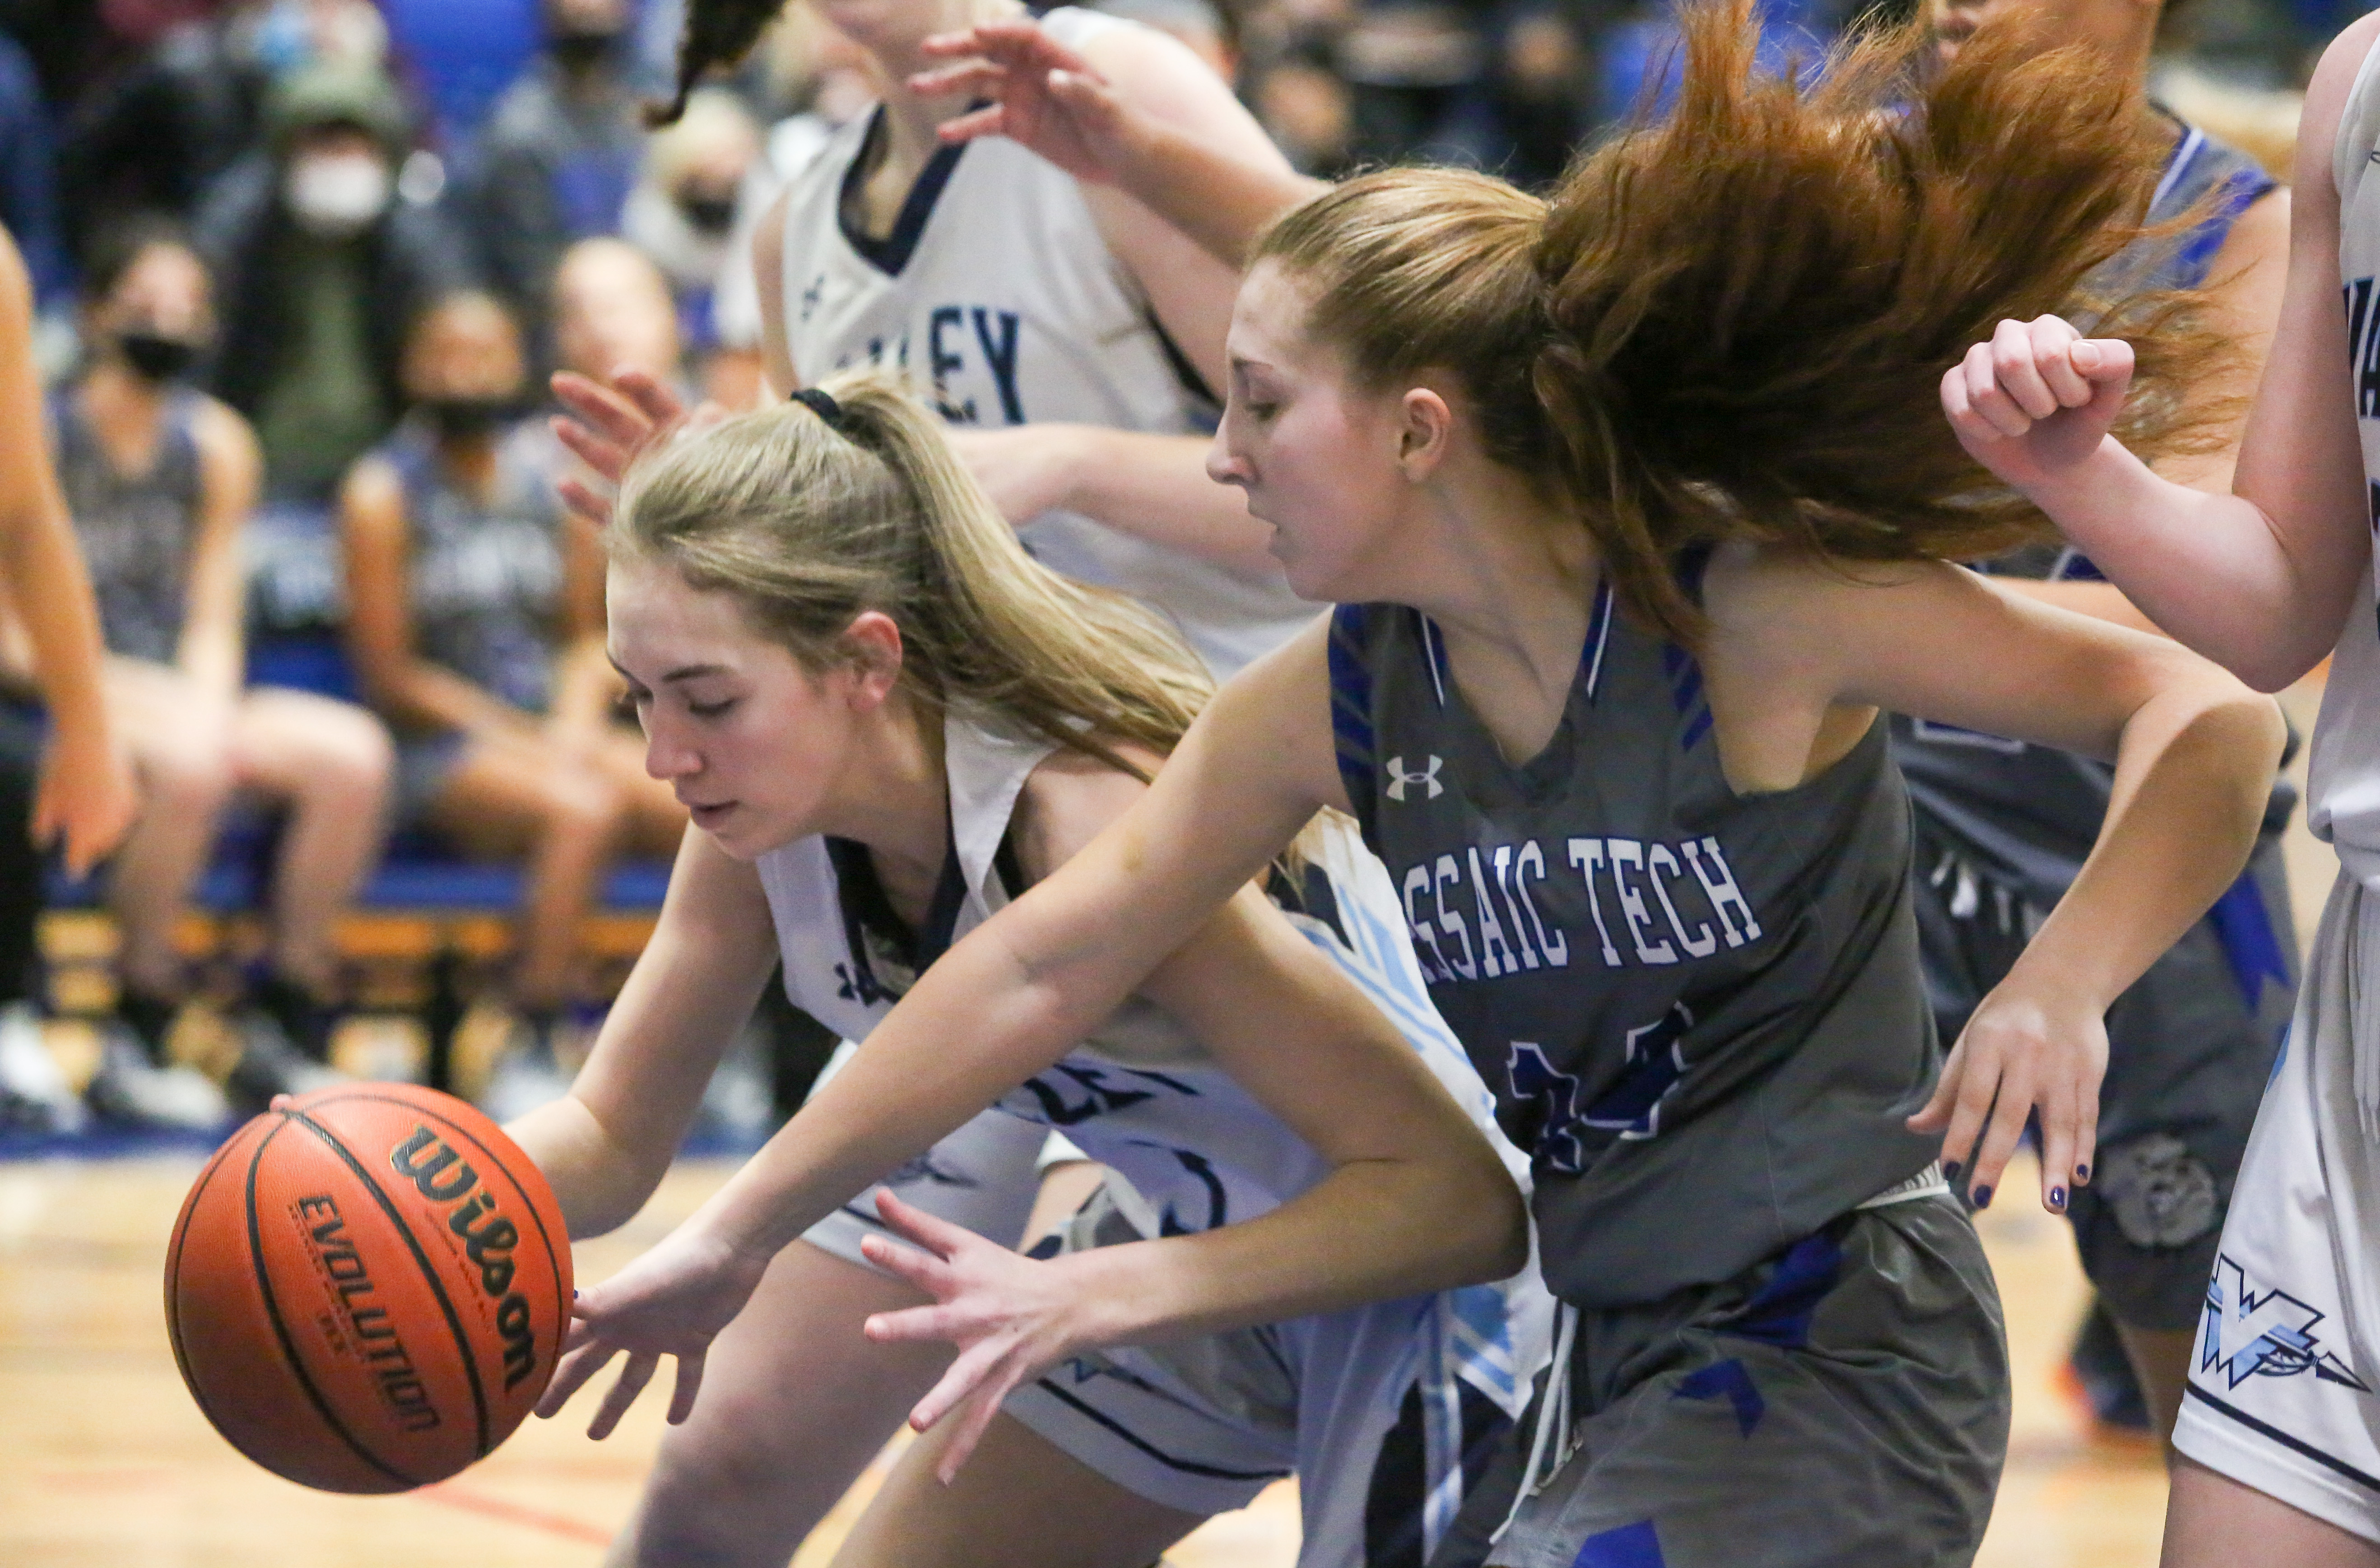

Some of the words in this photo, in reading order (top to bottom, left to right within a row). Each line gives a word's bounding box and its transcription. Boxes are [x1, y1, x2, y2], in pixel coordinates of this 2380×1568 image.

[1404, 838, 1569, 986] SSAIC
[1567, 835, 1763, 967] TECH
[298, 1195, 441, 1432] EVOLUTION
[390, 1123, 536, 1394] Wilson
